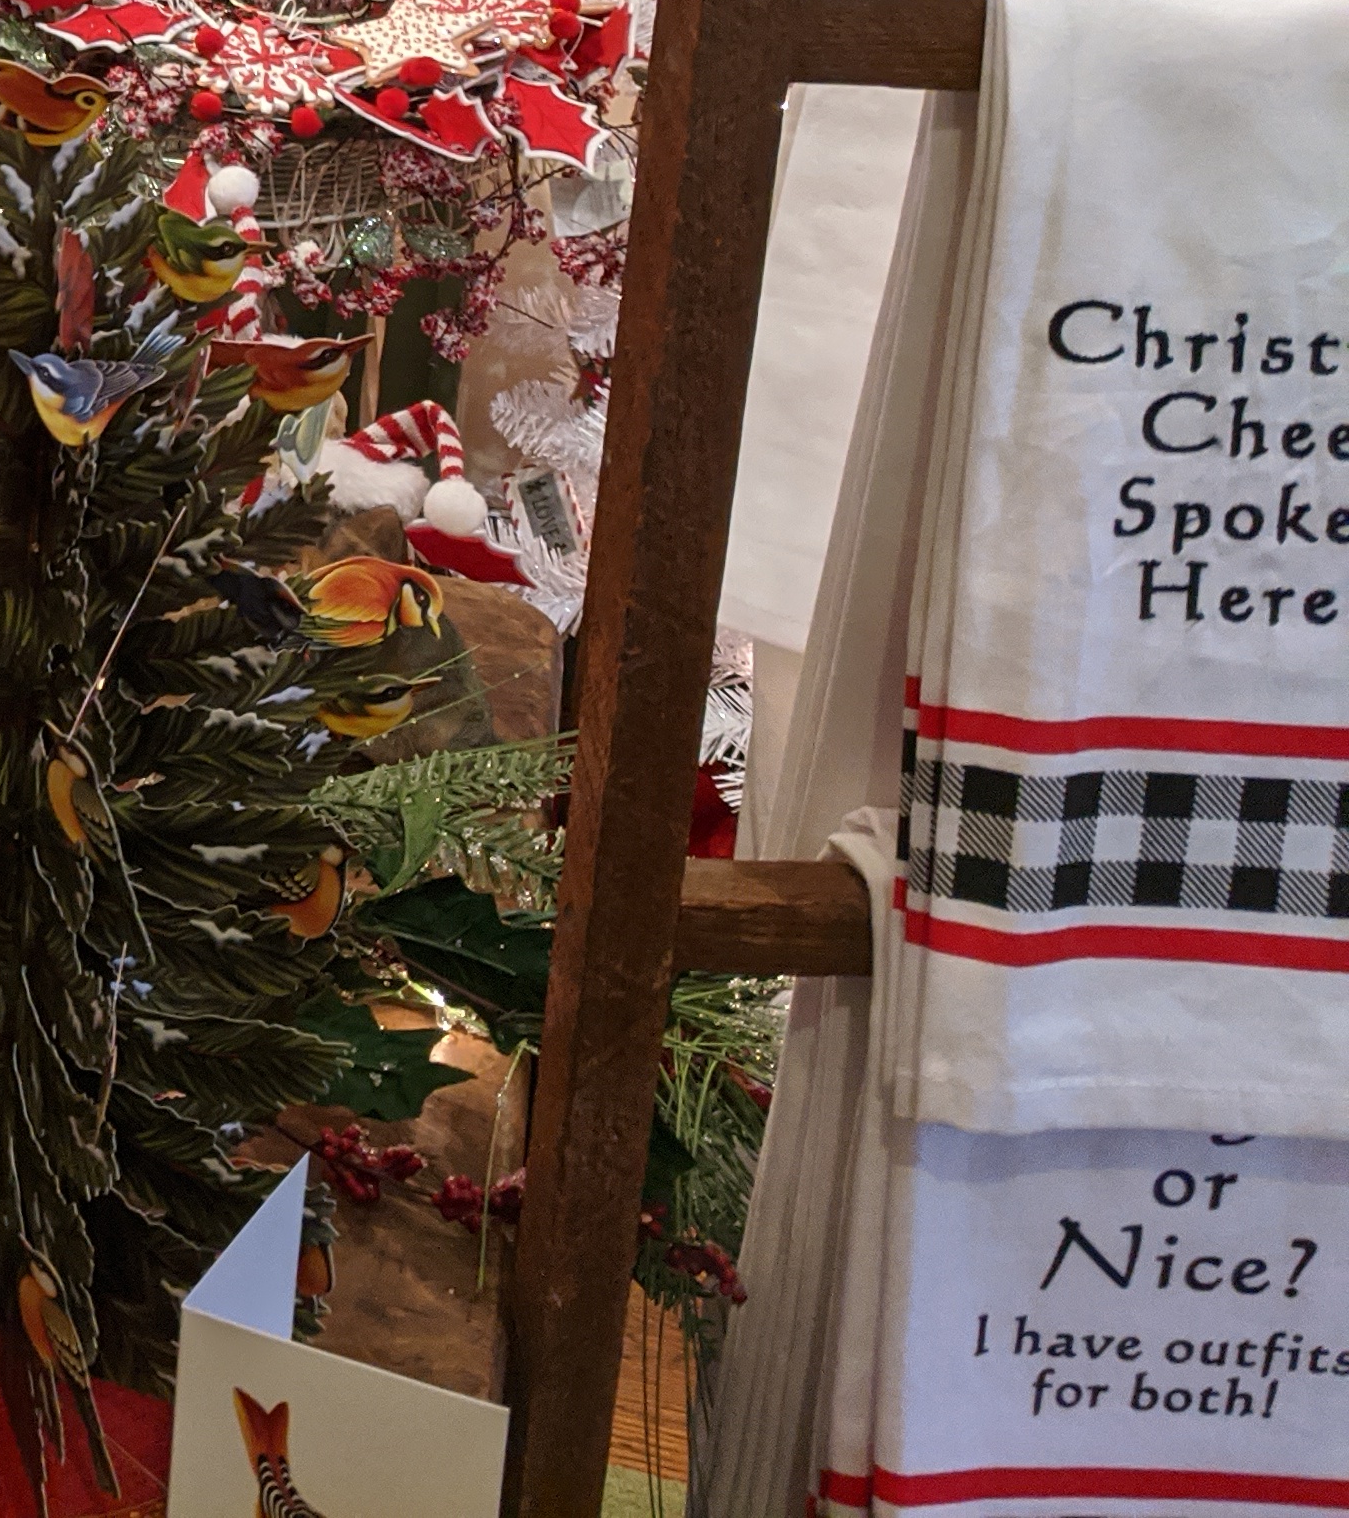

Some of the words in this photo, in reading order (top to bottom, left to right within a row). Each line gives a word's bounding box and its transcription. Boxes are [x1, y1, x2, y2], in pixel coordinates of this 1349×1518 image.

[1137, 558, 1339, 626] Here
[1152, 1168, 1239, 1211] or
[1038, 1215, 1319, 1299] Nice?
[973, 1313, 990, 1357] I
[1013, 1315, 1143, 1362] have
[1163, 1331, 1349, 1379] outfits
[1031, 1367, 1109, 1417] for
[1129, 1371, 1280, 1420] both!
